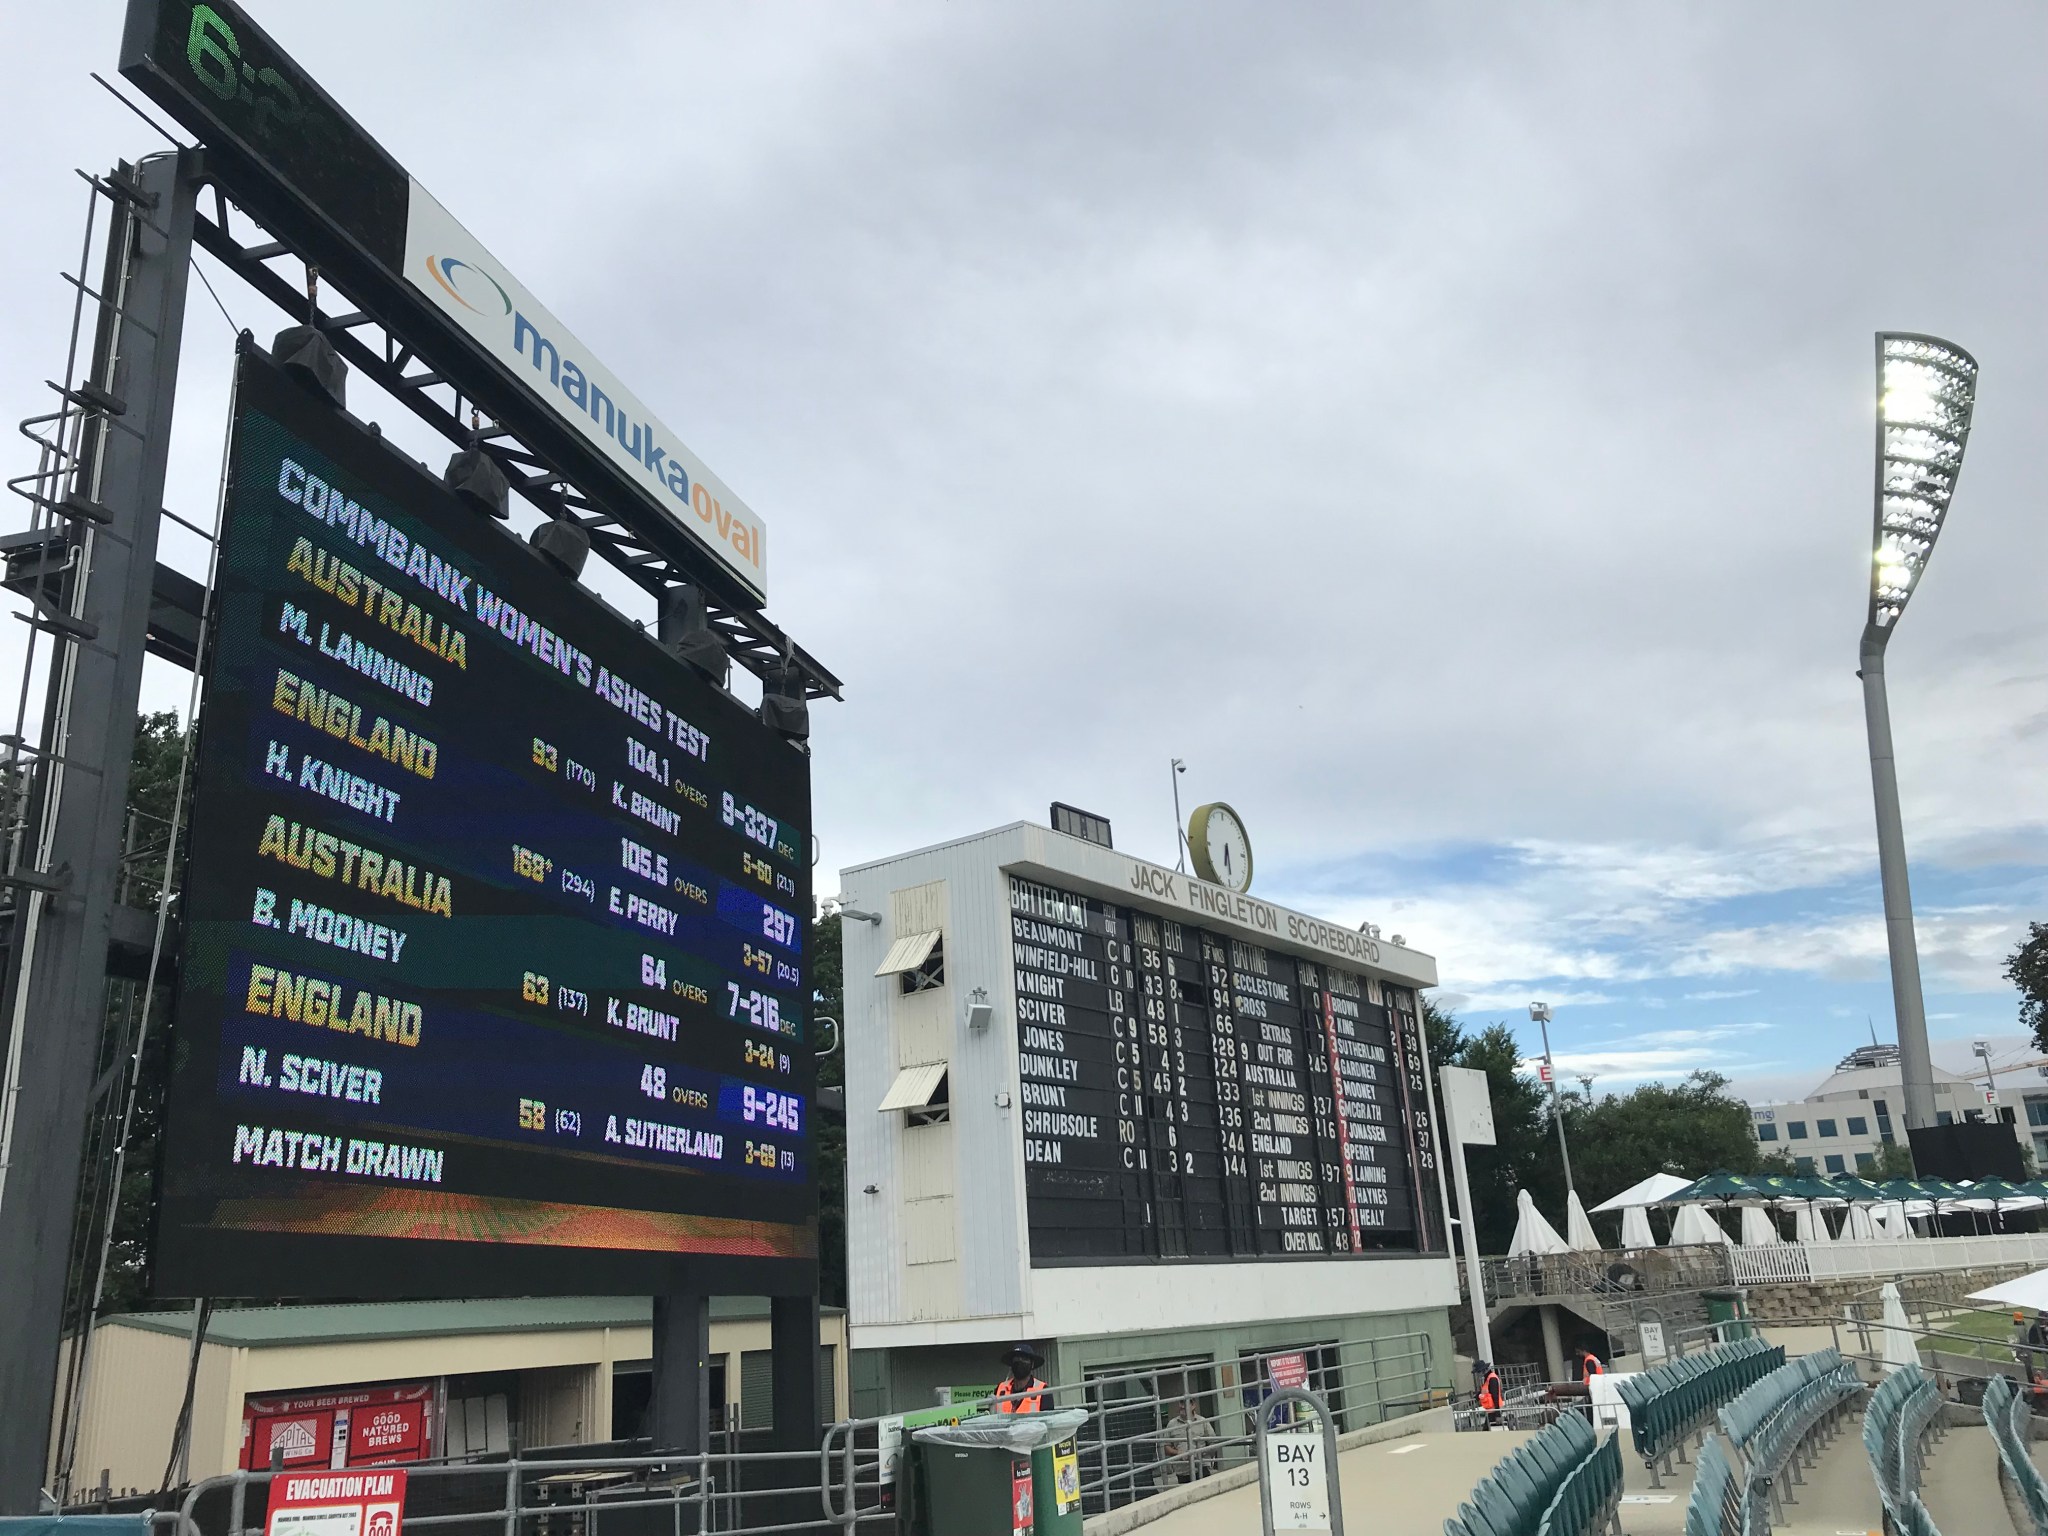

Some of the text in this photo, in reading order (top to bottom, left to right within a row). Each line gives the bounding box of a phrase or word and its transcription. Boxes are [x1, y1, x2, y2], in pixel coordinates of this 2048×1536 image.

[278, 457, 710, 762] COMMBANK WOMEN'S ASHES TEST
[287, 536, 794, 860] AUSTRALIA 104.1 OVERS 9-337 DEC
[279, 601, 313, 646] M.
[319, 621, 434, 707] LANNING
[532, 737, 558, 773] 93
[566, 757, 596, 793] (170)
[612, 781, 627, 810] K.
[631, 791, 681, 836] BRUNT
[743, 851, 772, 886] 5-60
[272, 667, 795, 946] ENGLAND 105.5 OVERS 297
[265, 738, 293, 782] H.
[300, 754, 400, 823] KNIGHT
[561, 868, 595, 903] (294)
[609, 886, 624, 916] E.
[627, 893, 679, 936] PERRY
[743, 942, 773, 975] 3-57
[777, 960, 799, 987] (20.5)
[258, 813, 796, 1036] AUSTRALIA 64 OVERS 7-216 DEC
[1131, 865, 1380, 963] JACK FINGLETON SCOREBOARD
[1013, 917, 1228, 988] BEAUMONT 36 52
[1231, 940, 1269, 976] BATTING
[252, 886, 791, 1075] B. MOONEY 63 (137) K. BRUNT 3-24 (9)
[1014, 942, 1230, 1009] WINFIELD-HILL 33 94
[1234, 971, 1289, 1001] ECCLESTONE
[1016, 969, 1234, 1034] KNIGHT LB 48 66
[1238, 995, 1267, 1018] CROSS
[1018, 997, 1168, 1046] SCIVER 58
[1331, 996, 1415, 1033] BROWN 18
[1023, 1025, 1065, 1052] JONES
[1260, 1021, 1292, 1045] EXTRAS
[1336, 1017, 1418, 1052] KING 39
[245, 962, 799, 1131] ENGLAND 48 OVERS 9-245
[1240, 1041, 1293, 1066] 9 OUT FOR
[1337, 1038, 1421, 1071] SUTHERLAND 69
[1020, 1052, 1171, 1094] DUNKLEY 45
[1245, 1063, 1297, 1088] AUSTRALIA
[1340, 1058, 1423, 1092] GARDNER 25
[1540, 1066, 1552, 1081] E
[1021, 1081, 1066, 1107] BRUNT
[1251, 1087, 1305, 1112] 1st INNINGS
[1343, 1080, 1377, 1100] MOONEY
[1986, 1091, 1995, 1103] F
[239, 1045, 795, 1172] N. SCIVER 58 (62) A. SUTHERLAND 3-69 (13)
[1415, 1111, 1428, 1128] 26
[1025, 1109, 1135, 1143] SHRUBSOLE RO
[1253, 1112, 1309, 1135] 2nd INNINGS
[1348, 1121, 1429, 1149] JONASSEN 37
[232, 1123, 444, 1183] MATCH DRAWN
[1025, 1138, 1062, 1163] DEAN
[1252, 1133, 1292, 1155] ENGLAND
[1350, 1144, 1434, 1169] PERRY 28
[1259, 1158, 1313, 1180] 1st INNINGS
[1354, 1164, 1387, 1184] LANNING
[1260, 1182, 1317, 1203] 2nd INNINGS
[1356, 1186, 1388, 1205] HAYNES
[1281, 1206, 1318, 1226] TARGET
[1360, 1208, 1385, 1226] HEALY
[1284, 1231, 1307, 1251] OVER
[1335, 1231, 1349, 1250] 48
[1644, 1326, 1659, 1334] BAY
[293, 1394, 370, 1409] YOUR BEER BREWED
[373, 1412, 400, 1426] GOOD
[368, 1434, 402, 1447] BREWS
[1277, 1444, 1316, 1463] BAY
[286, 1475, 394, 1501] EVACUATION PLAN
[1287, 1467, 1310, 1487] 13
[1290, 1501, 1312, 1509] ROWS
[1294, 1512, 1308, 1520] A-H
